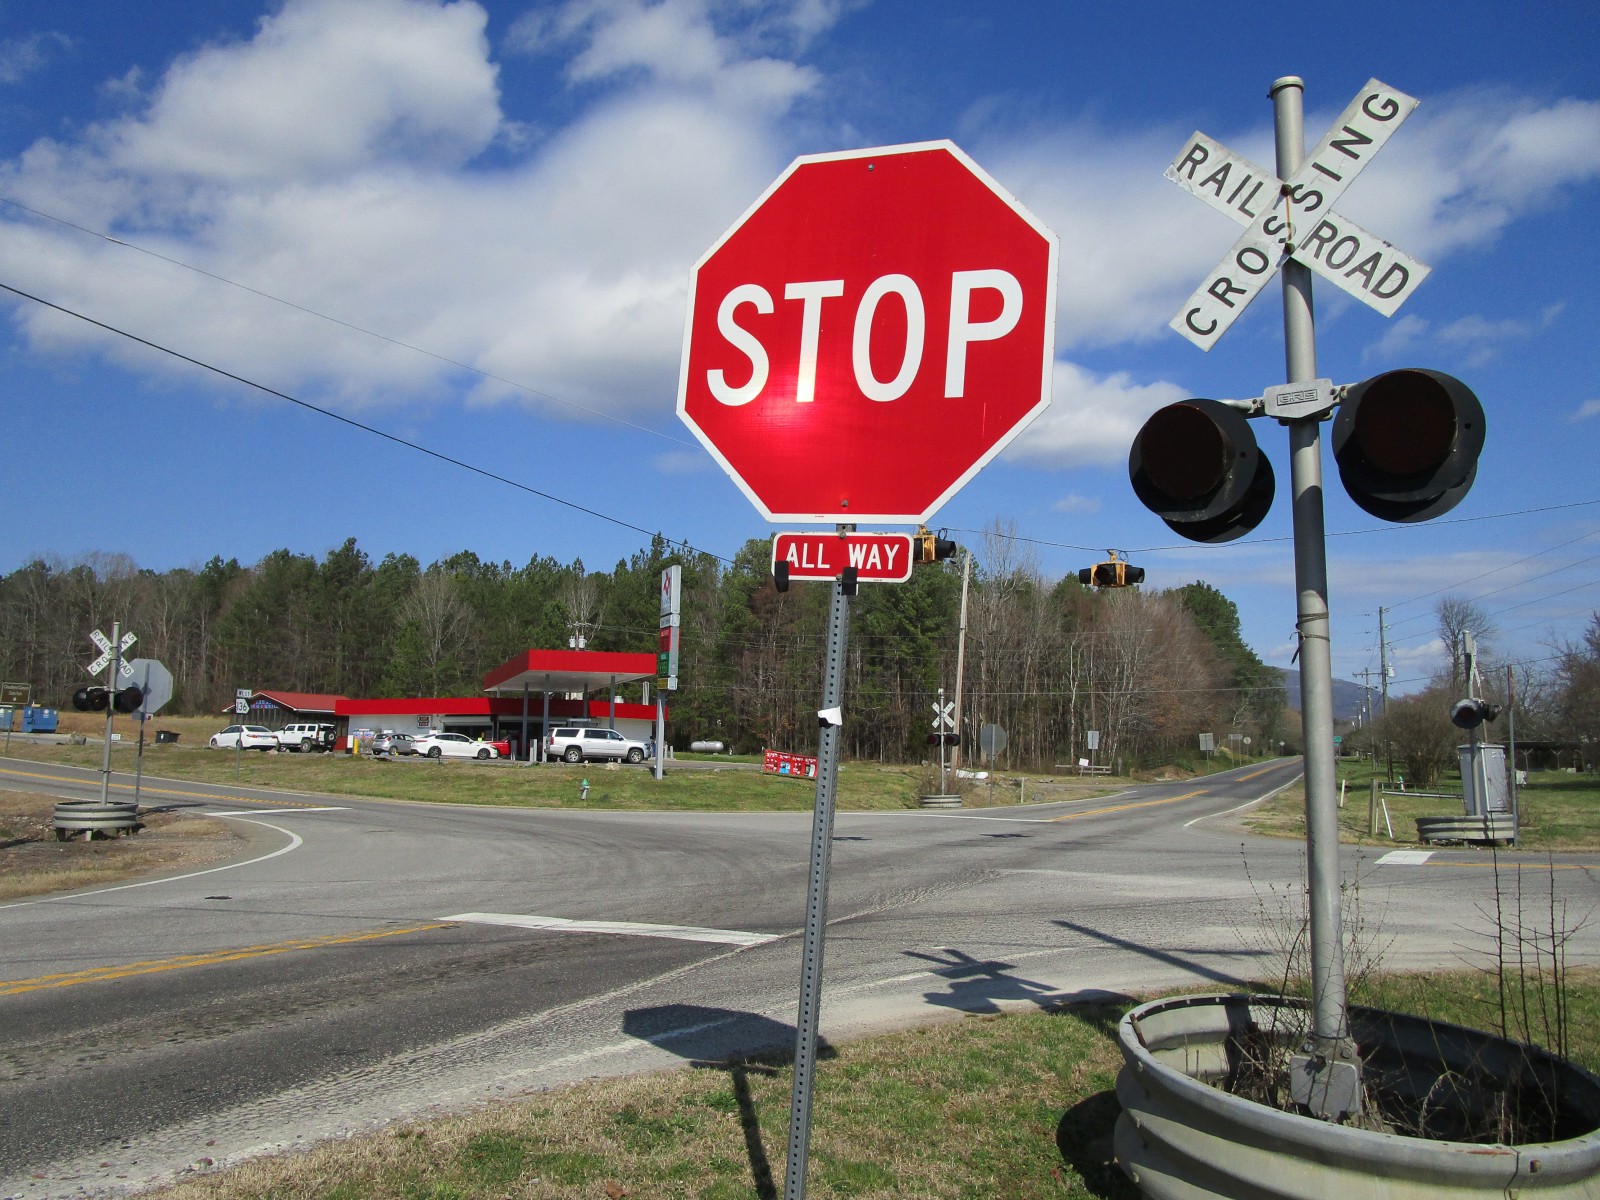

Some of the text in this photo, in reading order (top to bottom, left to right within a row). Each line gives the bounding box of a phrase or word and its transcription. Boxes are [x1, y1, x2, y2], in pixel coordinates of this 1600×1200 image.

[1176, 142, 1410, 300] RAIL ROAD
[1186, 93, 1400, 336] CROSSING
[707, 269, 1024, 407] STOP
[786, 543, 900, 571] ALL WAY
[90, 634, 135, 673] CROSING
[92, 631, 110, 652] RAIL
[236, 701, 248, 711] 136
